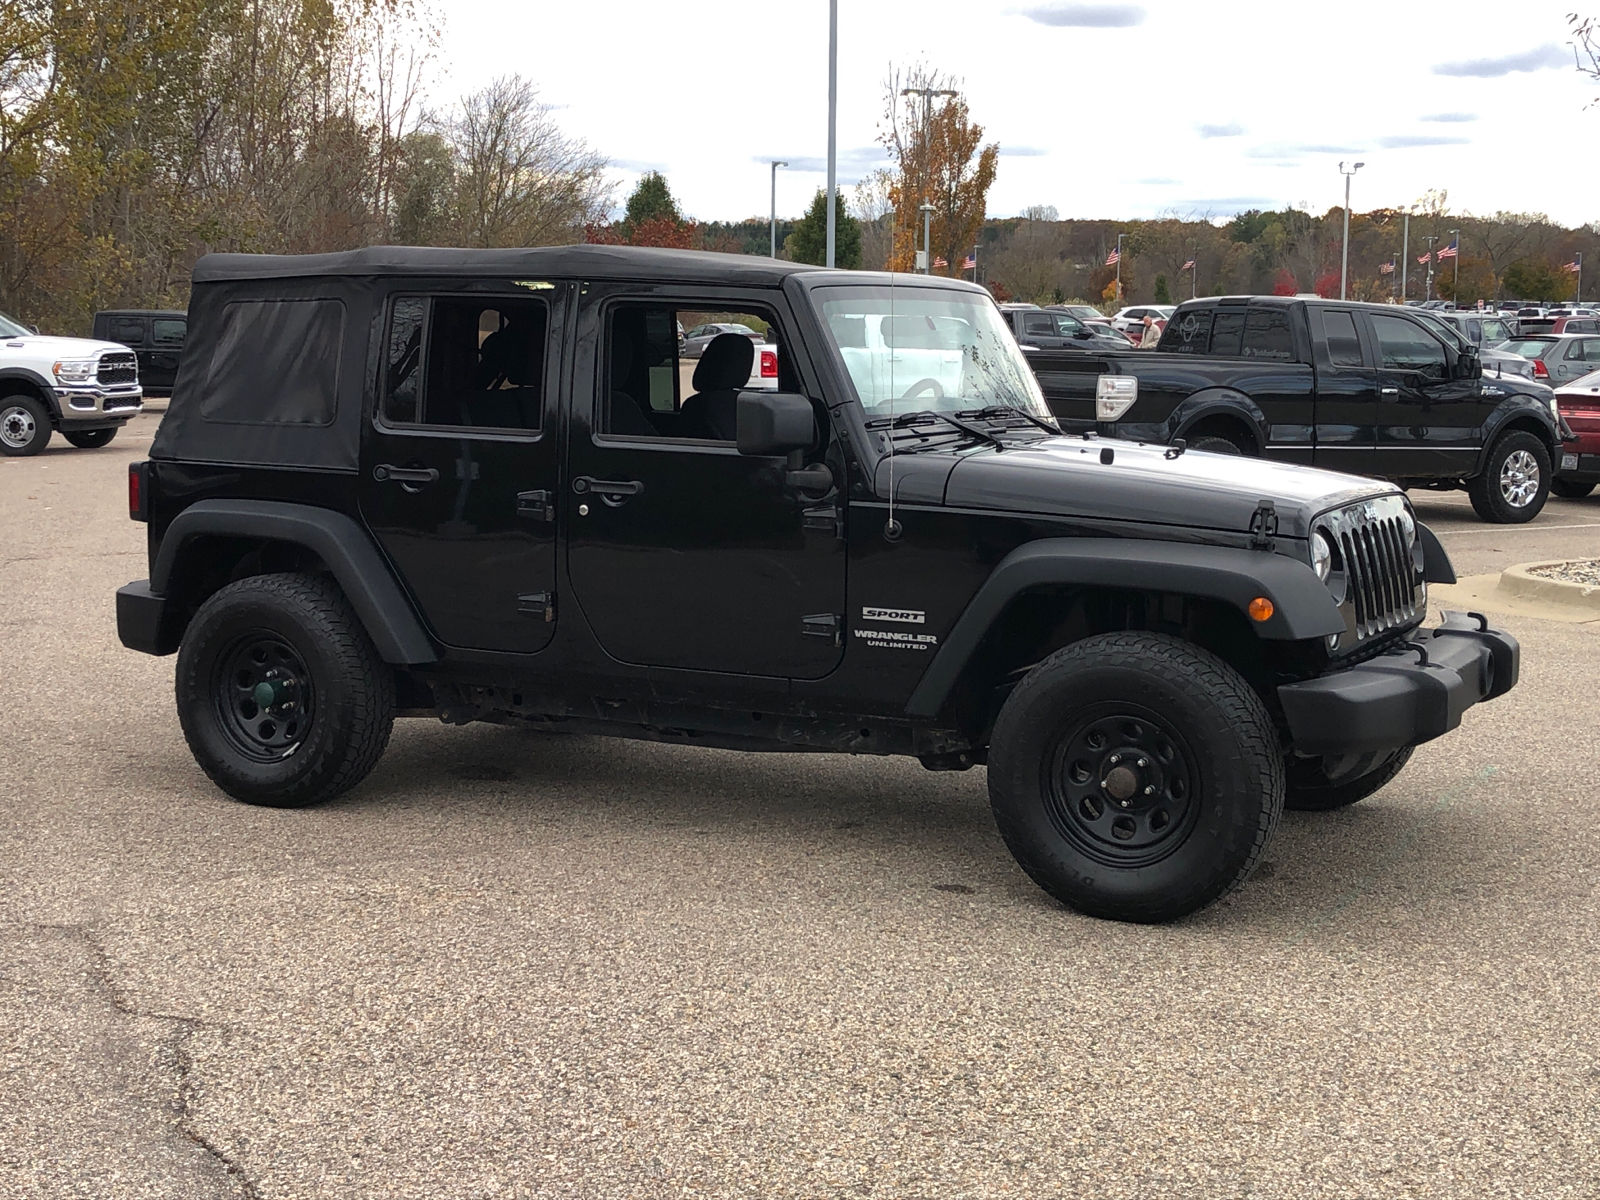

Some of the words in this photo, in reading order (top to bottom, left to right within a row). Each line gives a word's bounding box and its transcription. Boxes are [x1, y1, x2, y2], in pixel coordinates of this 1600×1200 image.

[866, 609, 921, 620] SPORT
[853, 629, 938, 645] WRANGLER
[866, 640, 928, 650] UNLIMITED
